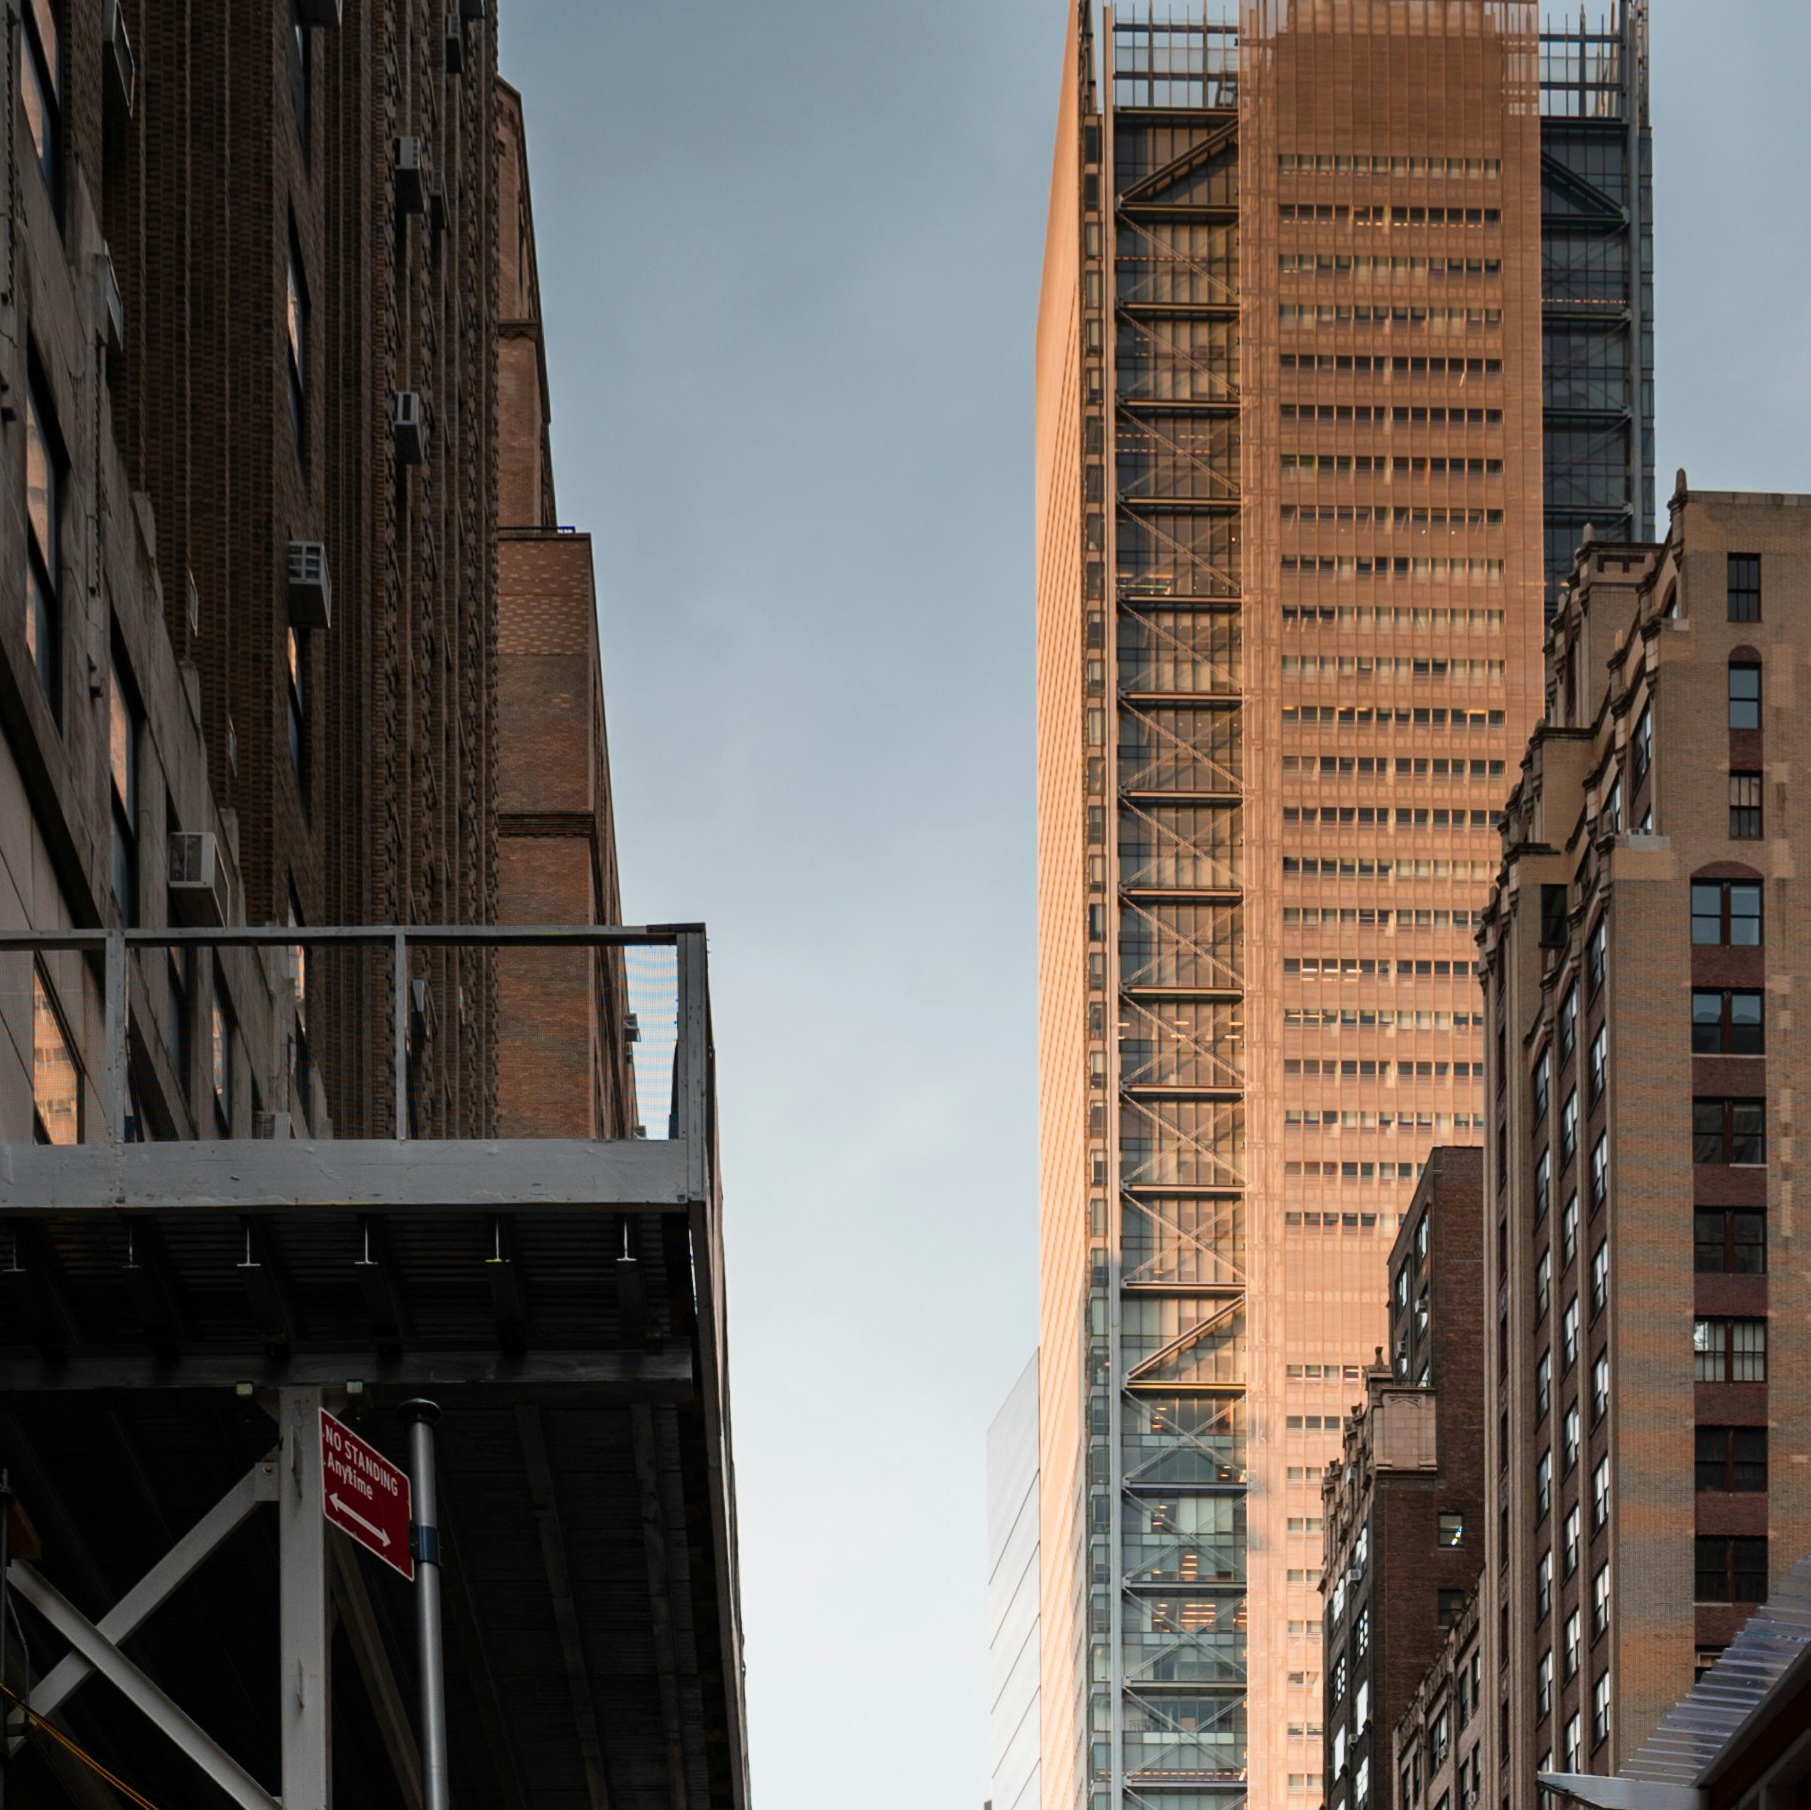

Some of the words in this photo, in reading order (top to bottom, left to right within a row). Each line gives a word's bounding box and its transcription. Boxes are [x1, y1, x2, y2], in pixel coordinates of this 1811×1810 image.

[325, 1423, 342, 1452] NO
[344, 1440, 399, 1497] STANDING
[327, 1451, 374, 1501] Anytime
